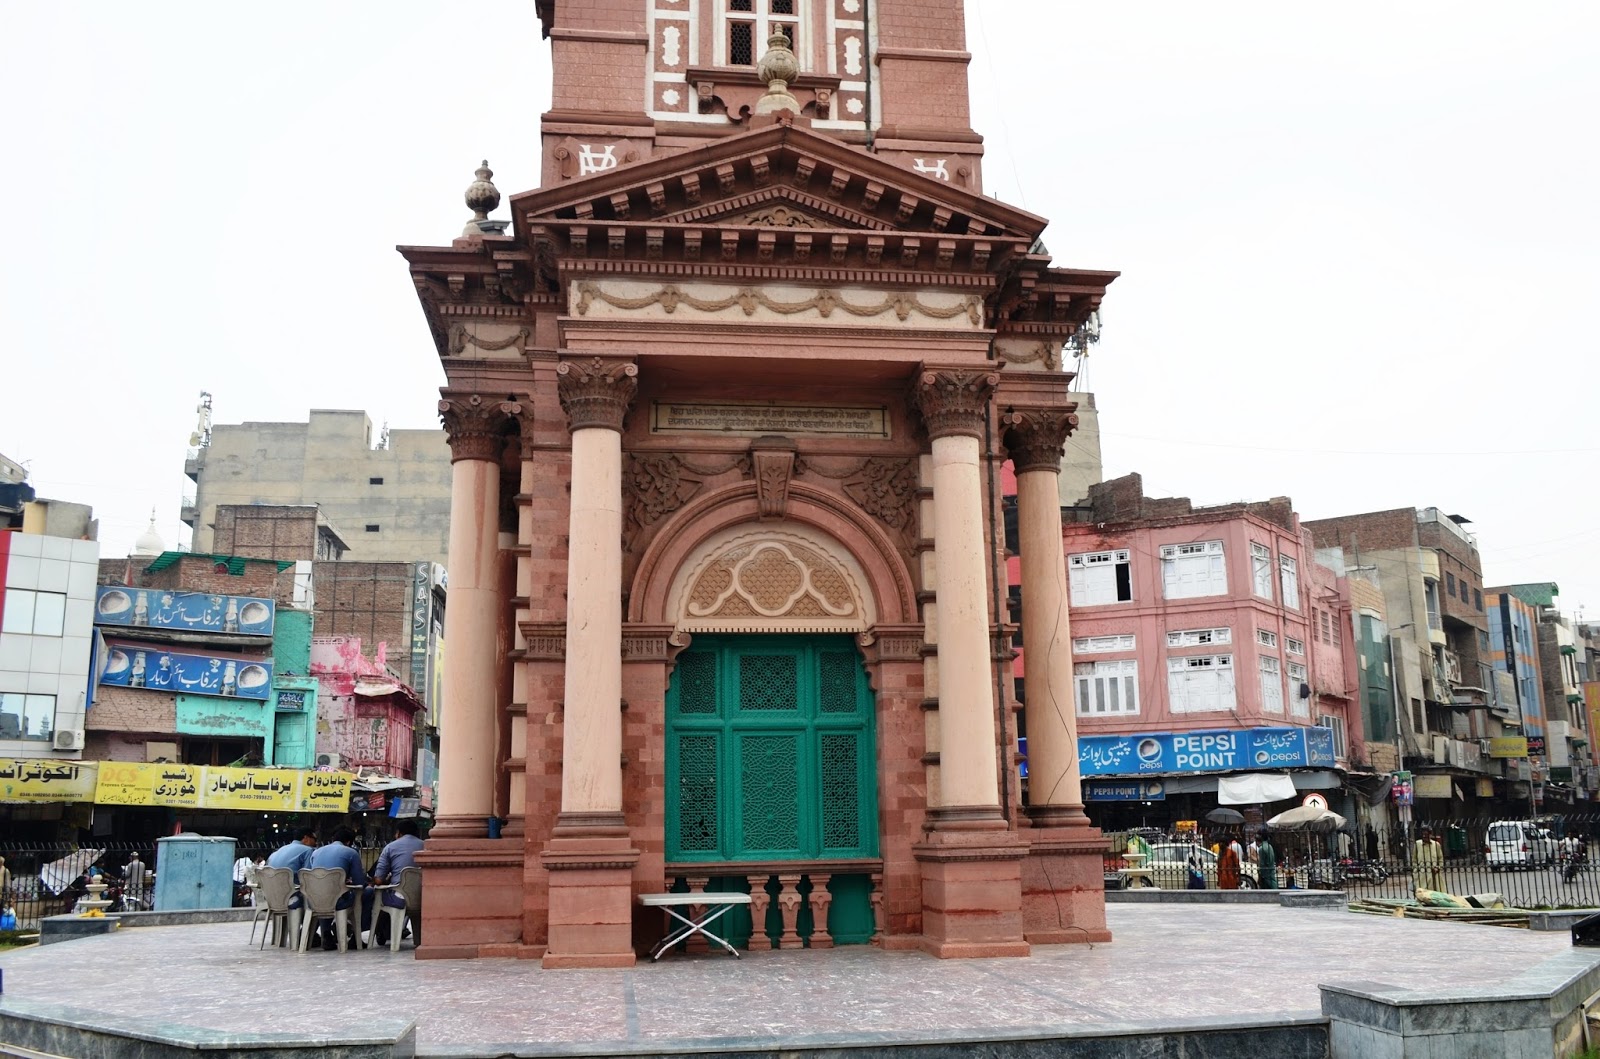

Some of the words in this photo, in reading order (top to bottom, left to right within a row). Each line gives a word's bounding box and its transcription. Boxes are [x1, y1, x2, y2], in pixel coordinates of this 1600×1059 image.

[1173, 734, 1236, 753] PEPSI
[1078, 744, 1102, 770] پوائن
[1176, 752, 1236, 769] POINT
[1270, 751, 1301, 762] pepsi
[1139, 761, 1163, 770] pepsi
[101, 767, 138, 782] DCS
[1093, 787, 1114, 796] PEPSI
[1115, 787, 1137, 796] POINT
